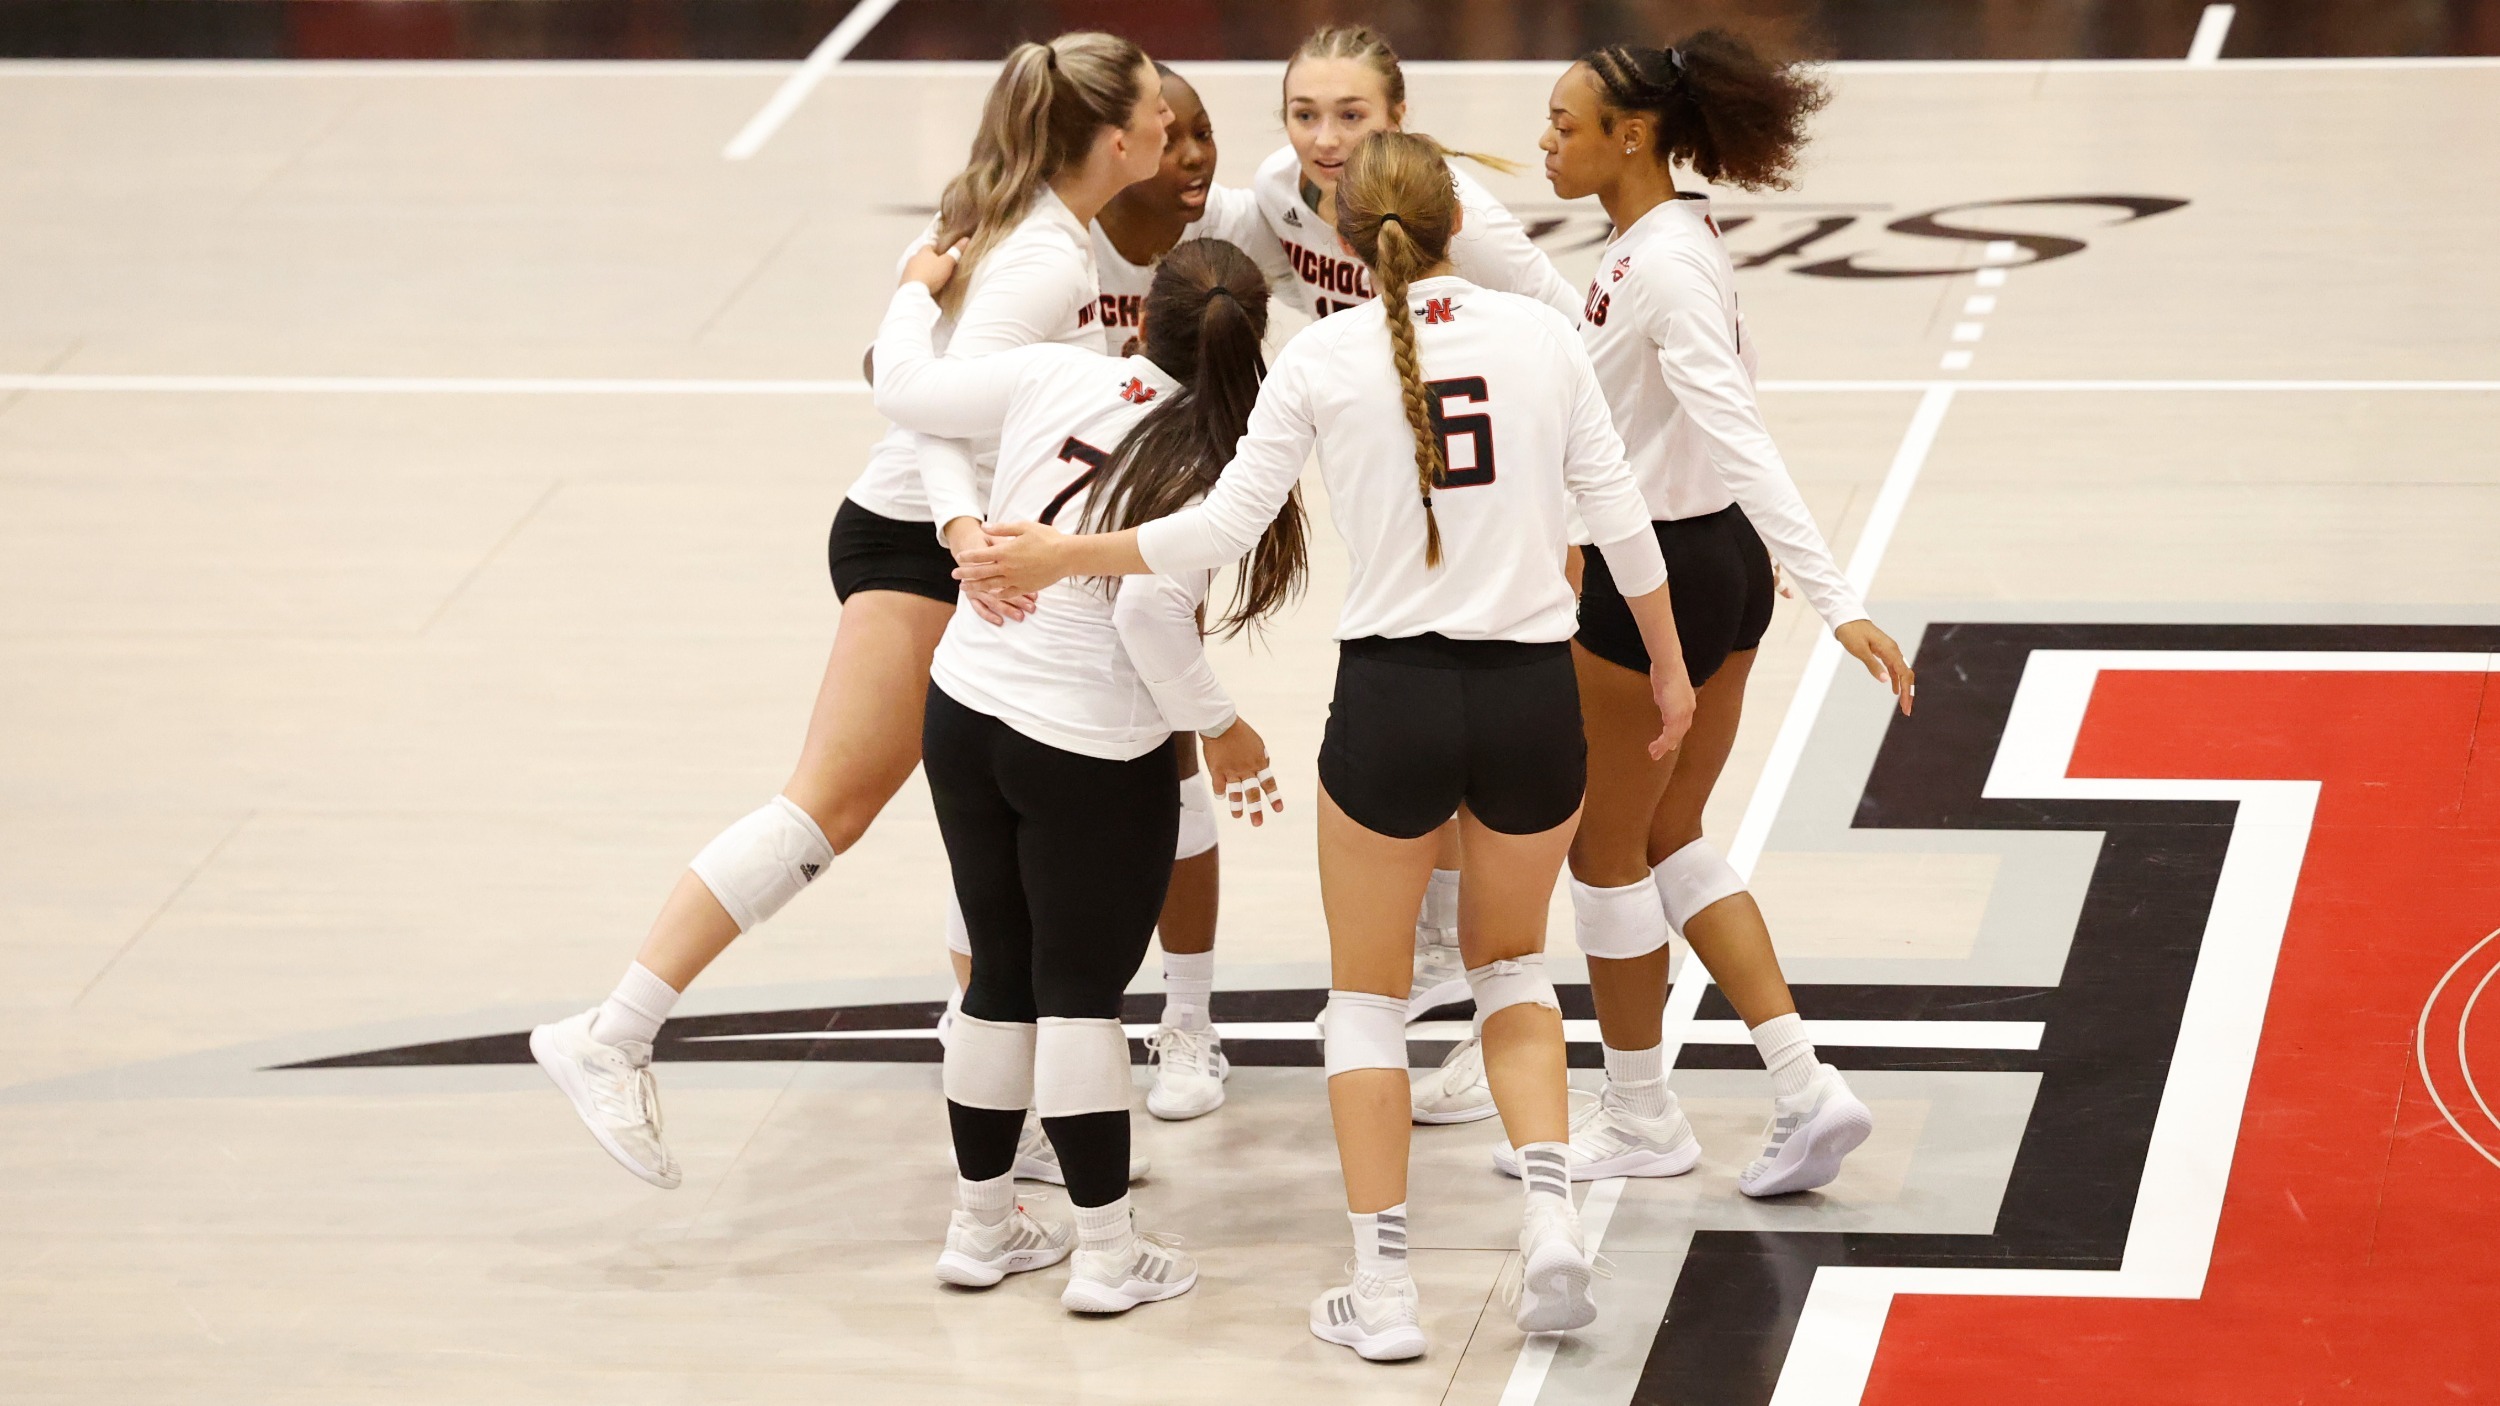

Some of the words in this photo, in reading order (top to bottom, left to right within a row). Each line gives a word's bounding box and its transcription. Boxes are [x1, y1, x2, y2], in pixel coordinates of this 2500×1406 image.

[1279, 237, 1377, 299] ICHOL
[1425, 297, 1455, 324] N
[1120, 376, 1157, 405] N
[1424, 375, 1496, 490] 6
[1038, 435, 1112, 526] 7
